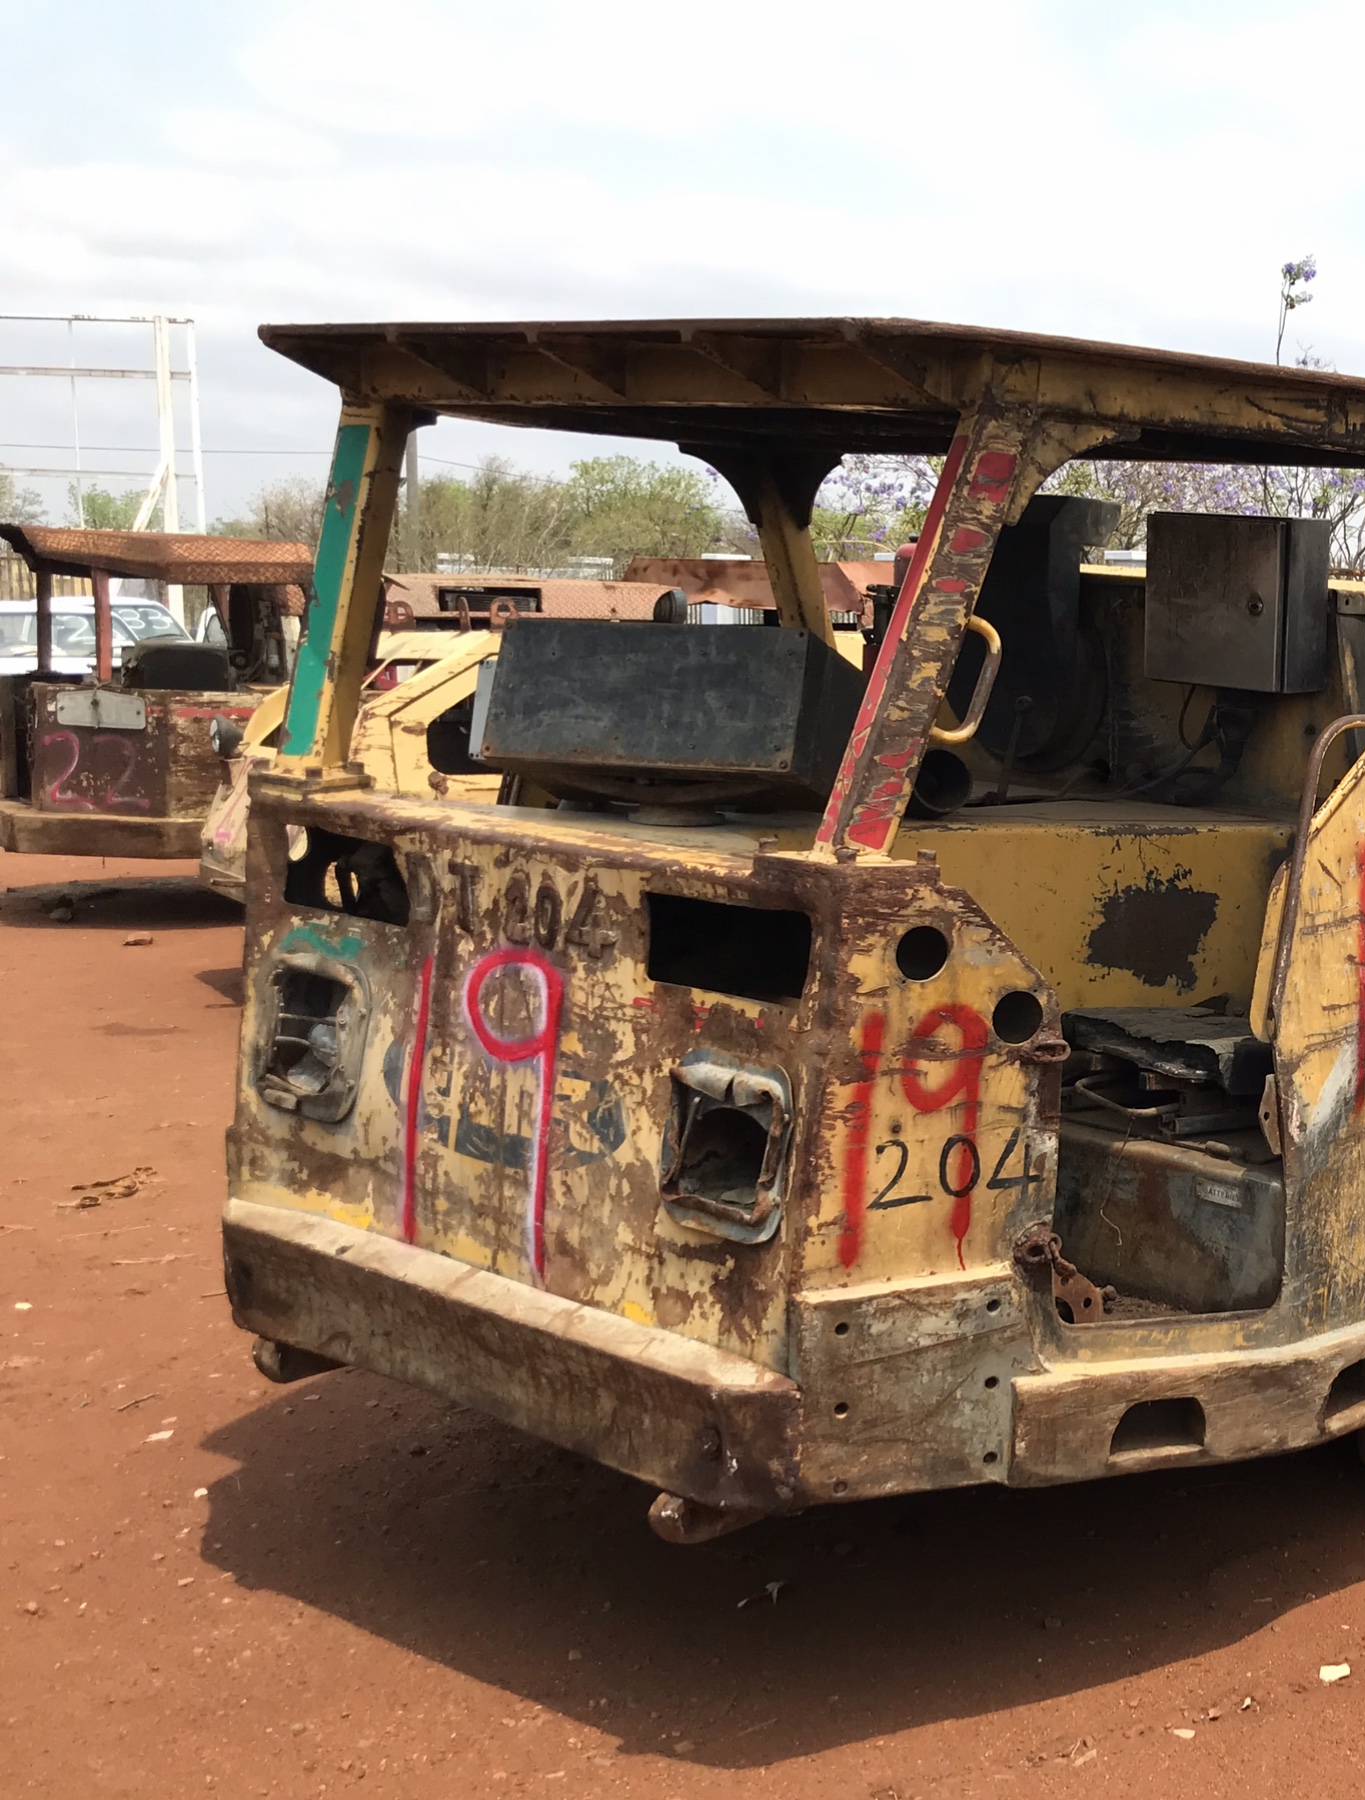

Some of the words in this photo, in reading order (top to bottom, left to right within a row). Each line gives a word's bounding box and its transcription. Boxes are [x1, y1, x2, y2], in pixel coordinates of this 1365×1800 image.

[44, 731, 149, 809] 22
[402, 947, 564, 1286] 19
[839, 1003, 988, 1270] 19
[867, 1126, 1045, 1210] 204
